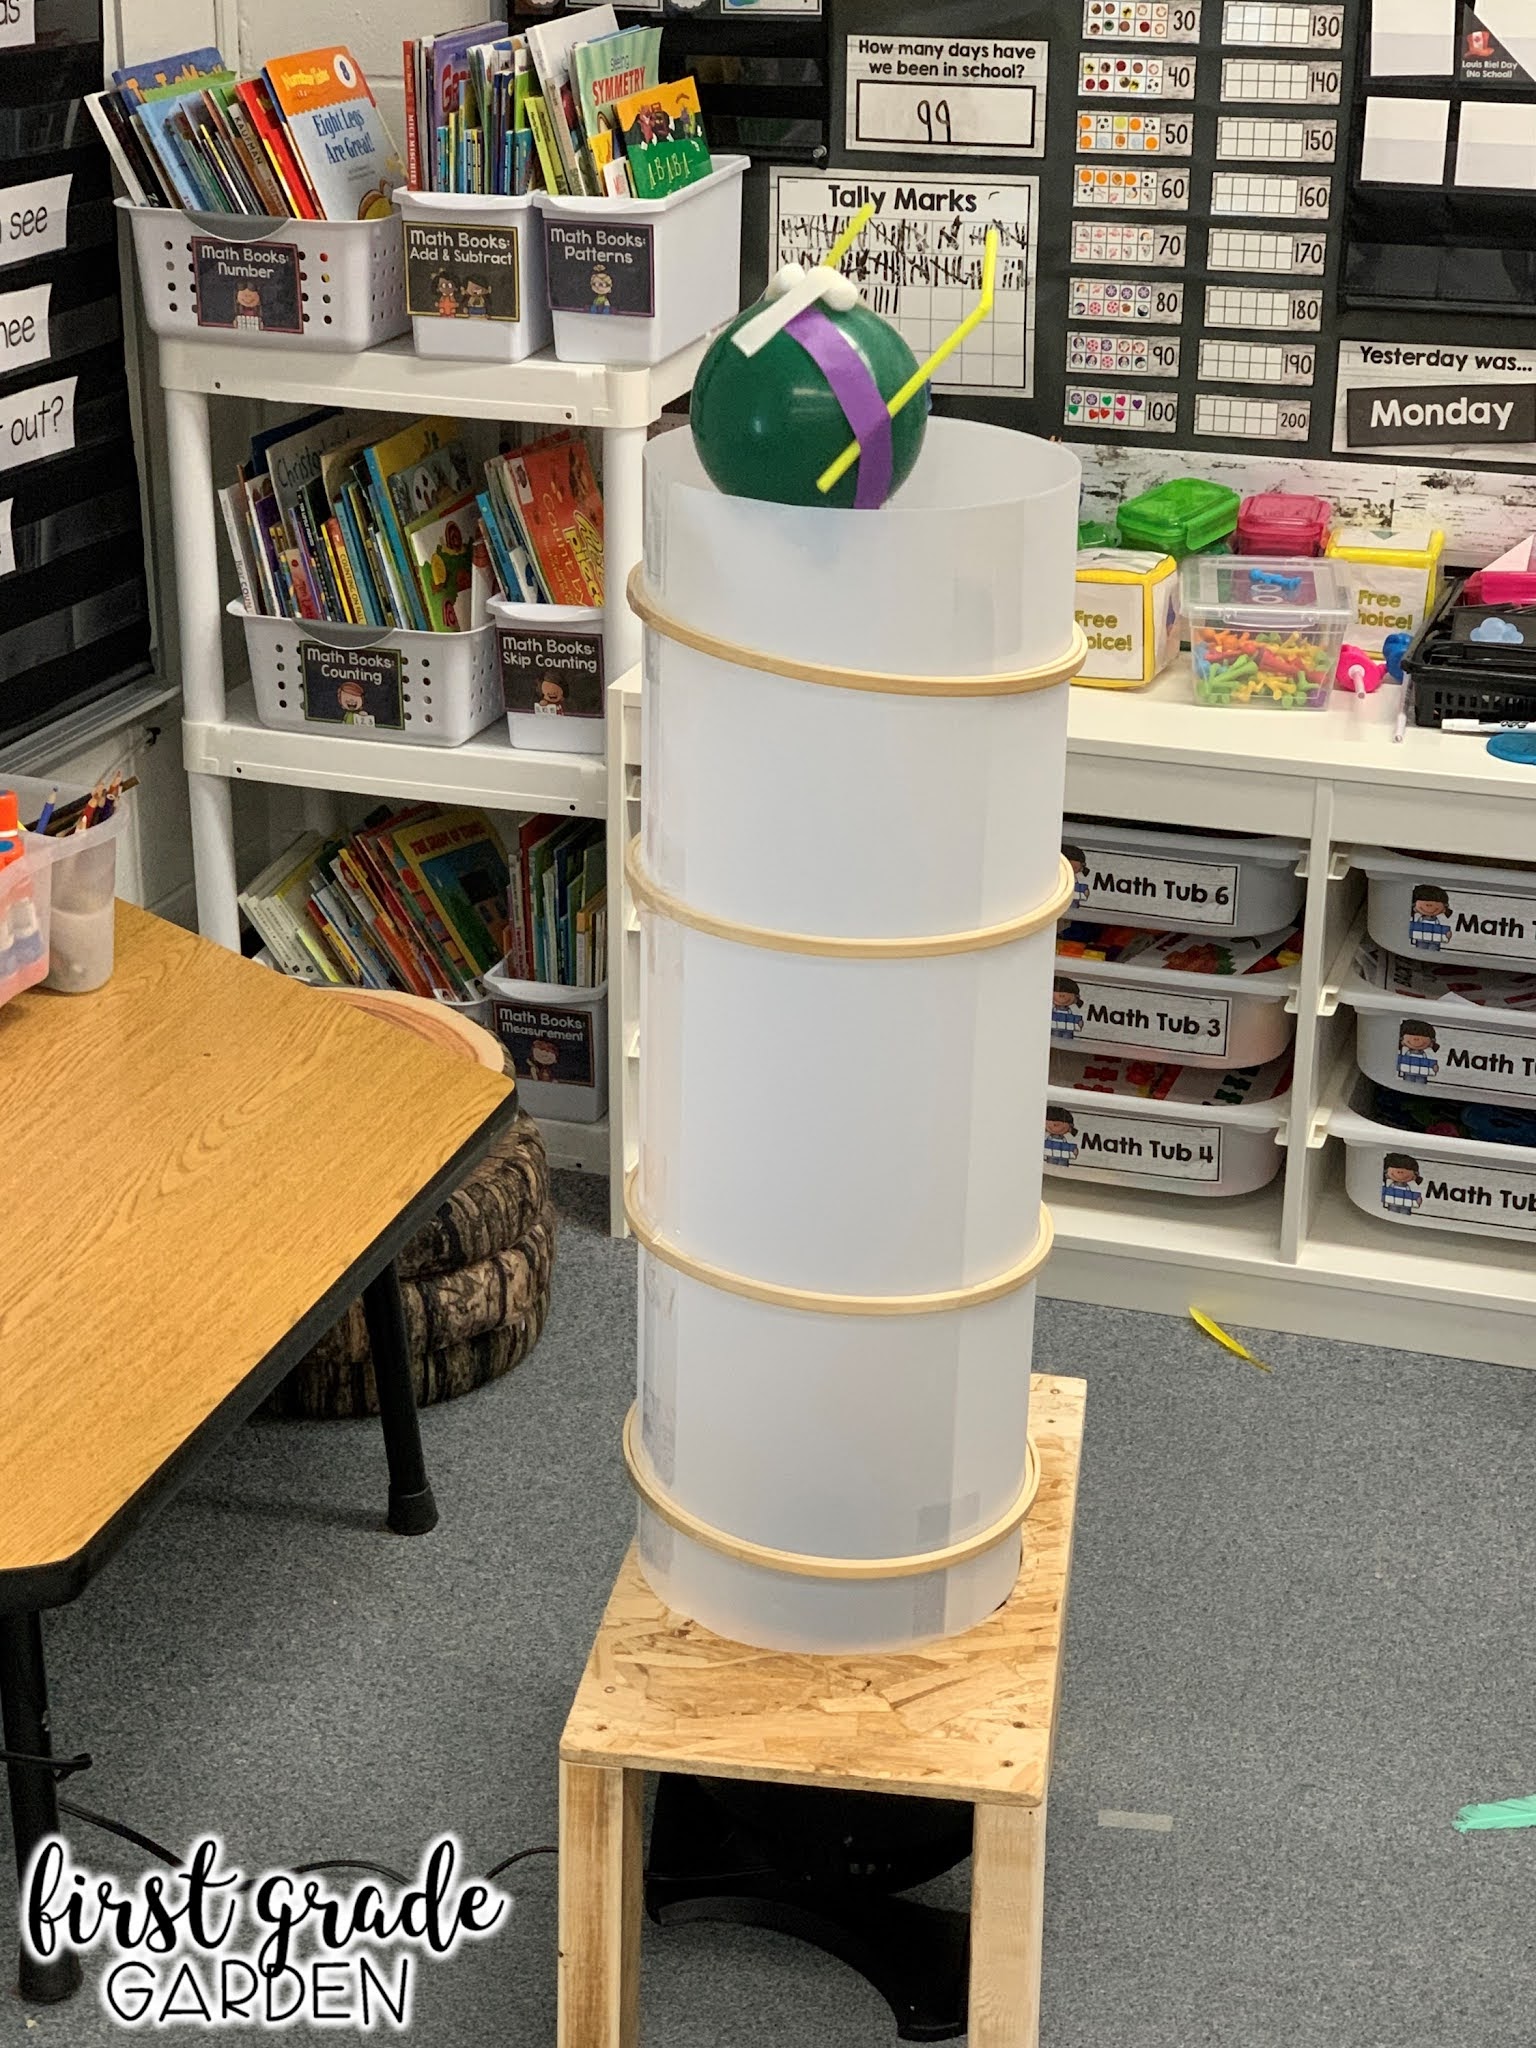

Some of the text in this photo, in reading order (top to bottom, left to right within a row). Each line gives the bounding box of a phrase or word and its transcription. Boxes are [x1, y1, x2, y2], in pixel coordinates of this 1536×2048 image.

[1173, 10, 1196, 32] 30
[1312, 14, 1340, 38] 130
[858, 39, 1036, 61] How many days have
[339, 60, 351, 81] 8
[869, 60, 1025, 80] we been in school?
[1462, 60, 1482, 69] Louis
[1501, 60, 1518, 70] Day
[592, 65, 646, 107] SYMMETRY
[1167, 66, 1191, 89] 40
[1310, 70, 1338, 94] 140
[312, 107, 365, 140] Eight Legs
[1165, 123, 1188, 145] 50
[234, 116, 262, 165] KAUFMAN
[325, 132, 376, 165] Are Great!
[1305, 129, 1333, 152] 150
[828, 183, 977, 214] Tally Marks
[1161, 178, 1185, 200] 60
[1299, 185, 1328, 208] 160
[10, 206, 48, 240] see
[410, 229, 511, 250] Math Books:
[550, 227, 647, 248] Math Books:
[1158, 234, 1181, 257] 70
[202, 245, 240, 261] Math
[409, 247, 513, 266] Add & Subtract
[565, 245, 633, 265] Patterns
[1295, 242, 1323, 265] 170
[218, 261, 275, 279] Number
[1156, 291, 1178, 314] 80
[1291, 298, 1319, 321] 180
[1152, 345, 1175, 367] 90
[1284, 352, 1312, 375] 190
[1360, 345, 1533, 372] Yesterday was...
[11, 395, 64, 446] out?
[1147, 400, 1175, 423] 100
[1280, 412, 1306, 430] 200
[1370, 397, 1515, 430] Monday
[543, 492, 575, 573] Count
[241, 581, 254, 609] COUN
[340, 553, 365, 622] COUNTING ON FALL
[1358, 589, 1402, 608] Free
[1074, 610, 1118, 629] Free
[502, 636, 596, 656] Math Books:
[1087, 632, 1132, 651] oice!
[307, 647, 346, 664] Math
[503, 651, 598, 674] Skip Counting
[321, 664, 383, 686] Counting
[1092, 872, 1229, 906] Math Tub 6
[1455, 913, 1524, 939] Math
[500, 1008, 537, 1025] Math
[1086, 1004, 1221, 1038] Math Tub 3
[502, 1021, 584, 1042] Measurement
[1446, 1048, 1514, 1075] Math
[1080, 1132, 1213, 1164] Math Tub 4
[1425, 1180, 1492, 1207] Math
